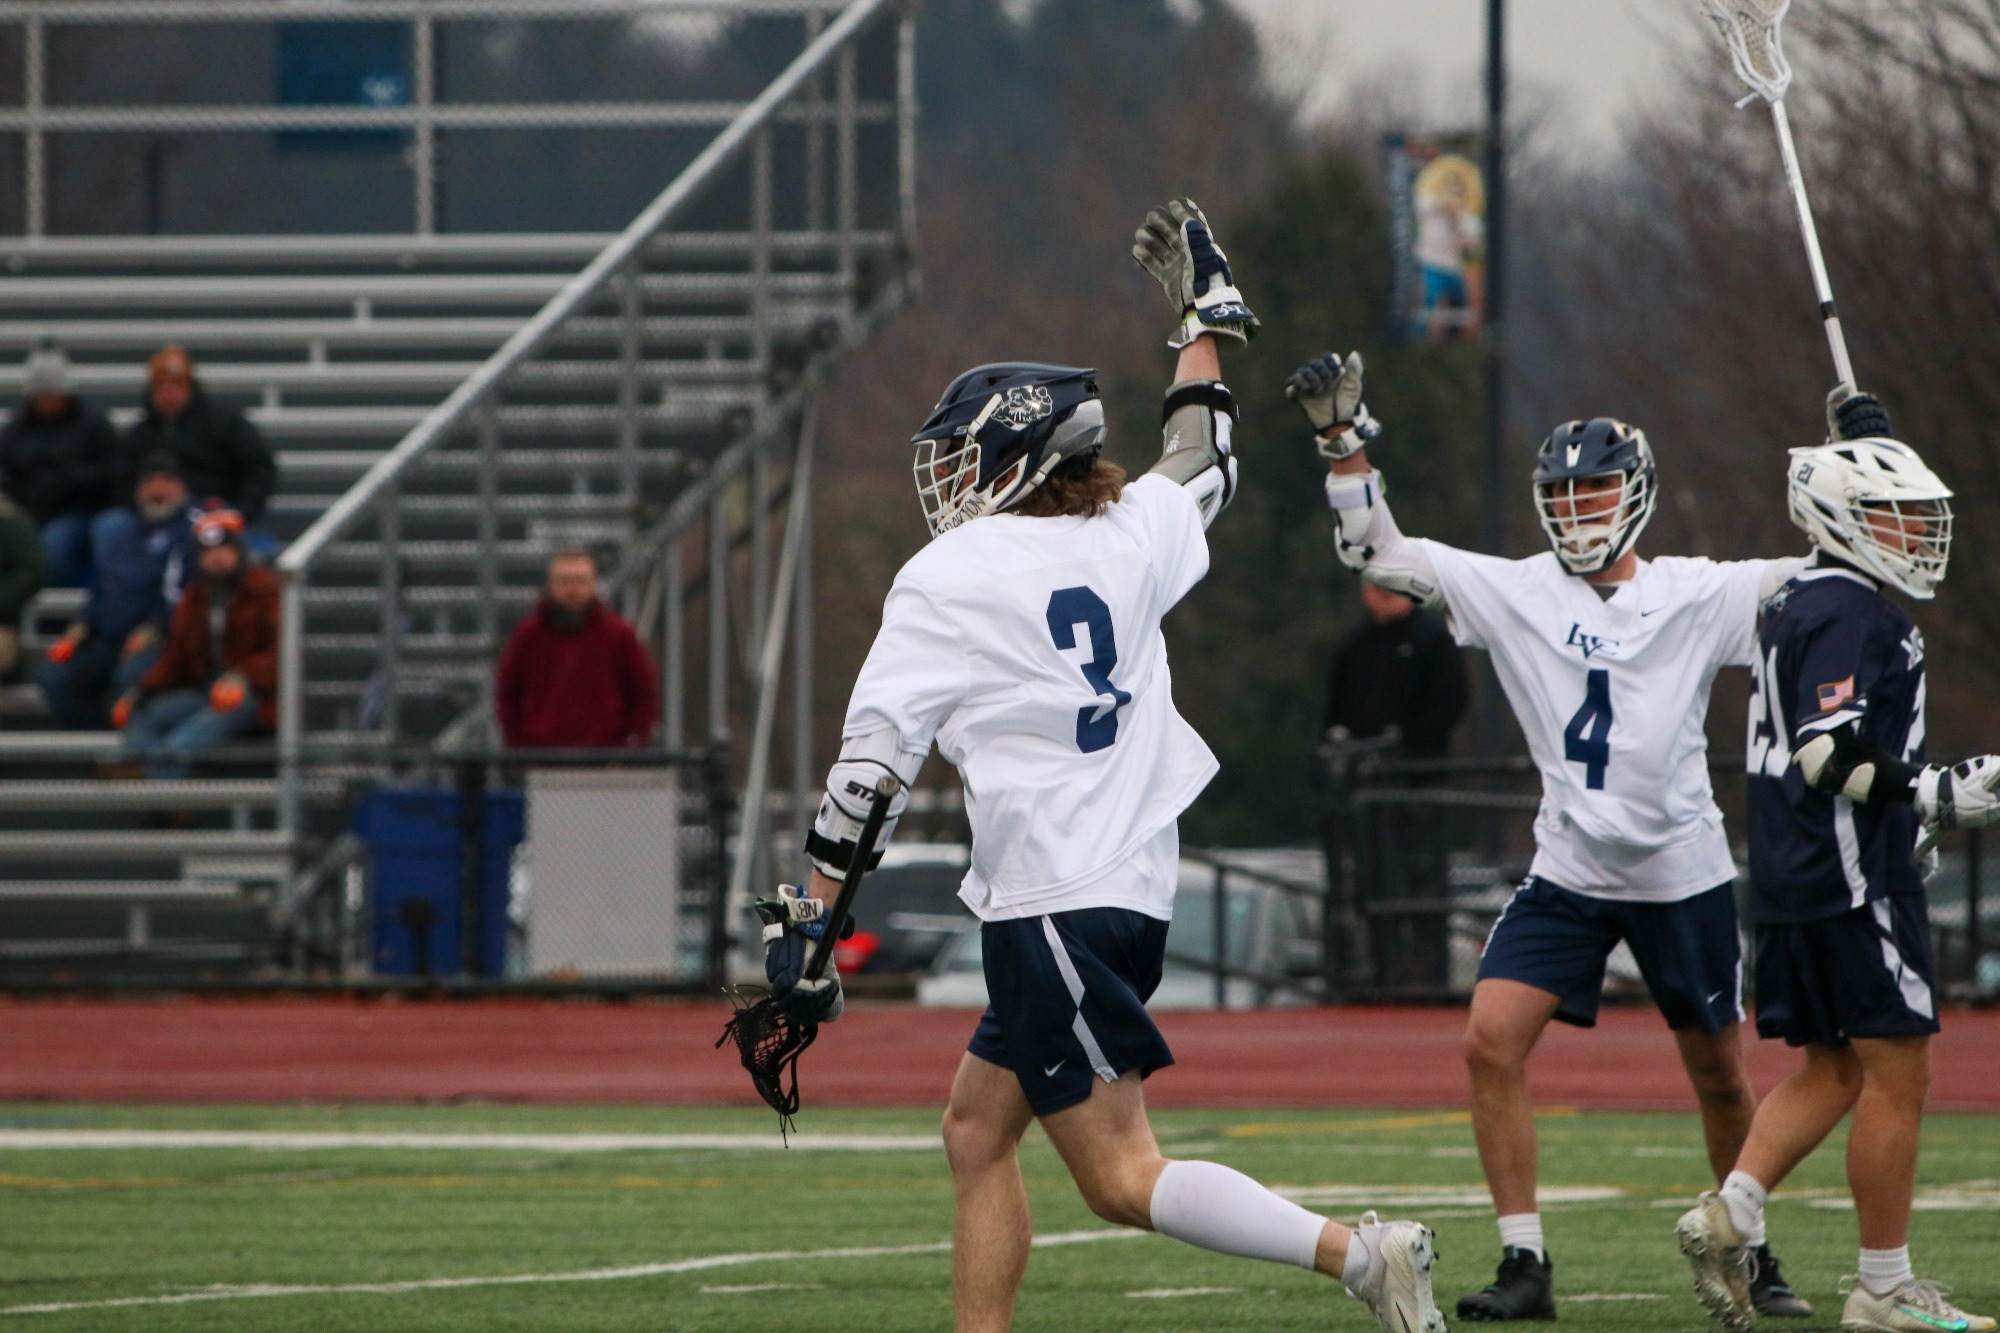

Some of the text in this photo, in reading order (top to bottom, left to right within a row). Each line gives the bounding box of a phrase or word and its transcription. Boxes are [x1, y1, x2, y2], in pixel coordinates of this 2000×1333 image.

[1797, 462, 1815, 486] 21
[1045, 585, 1132, 754] 3
[1563, 669, 1613, 791] 4
